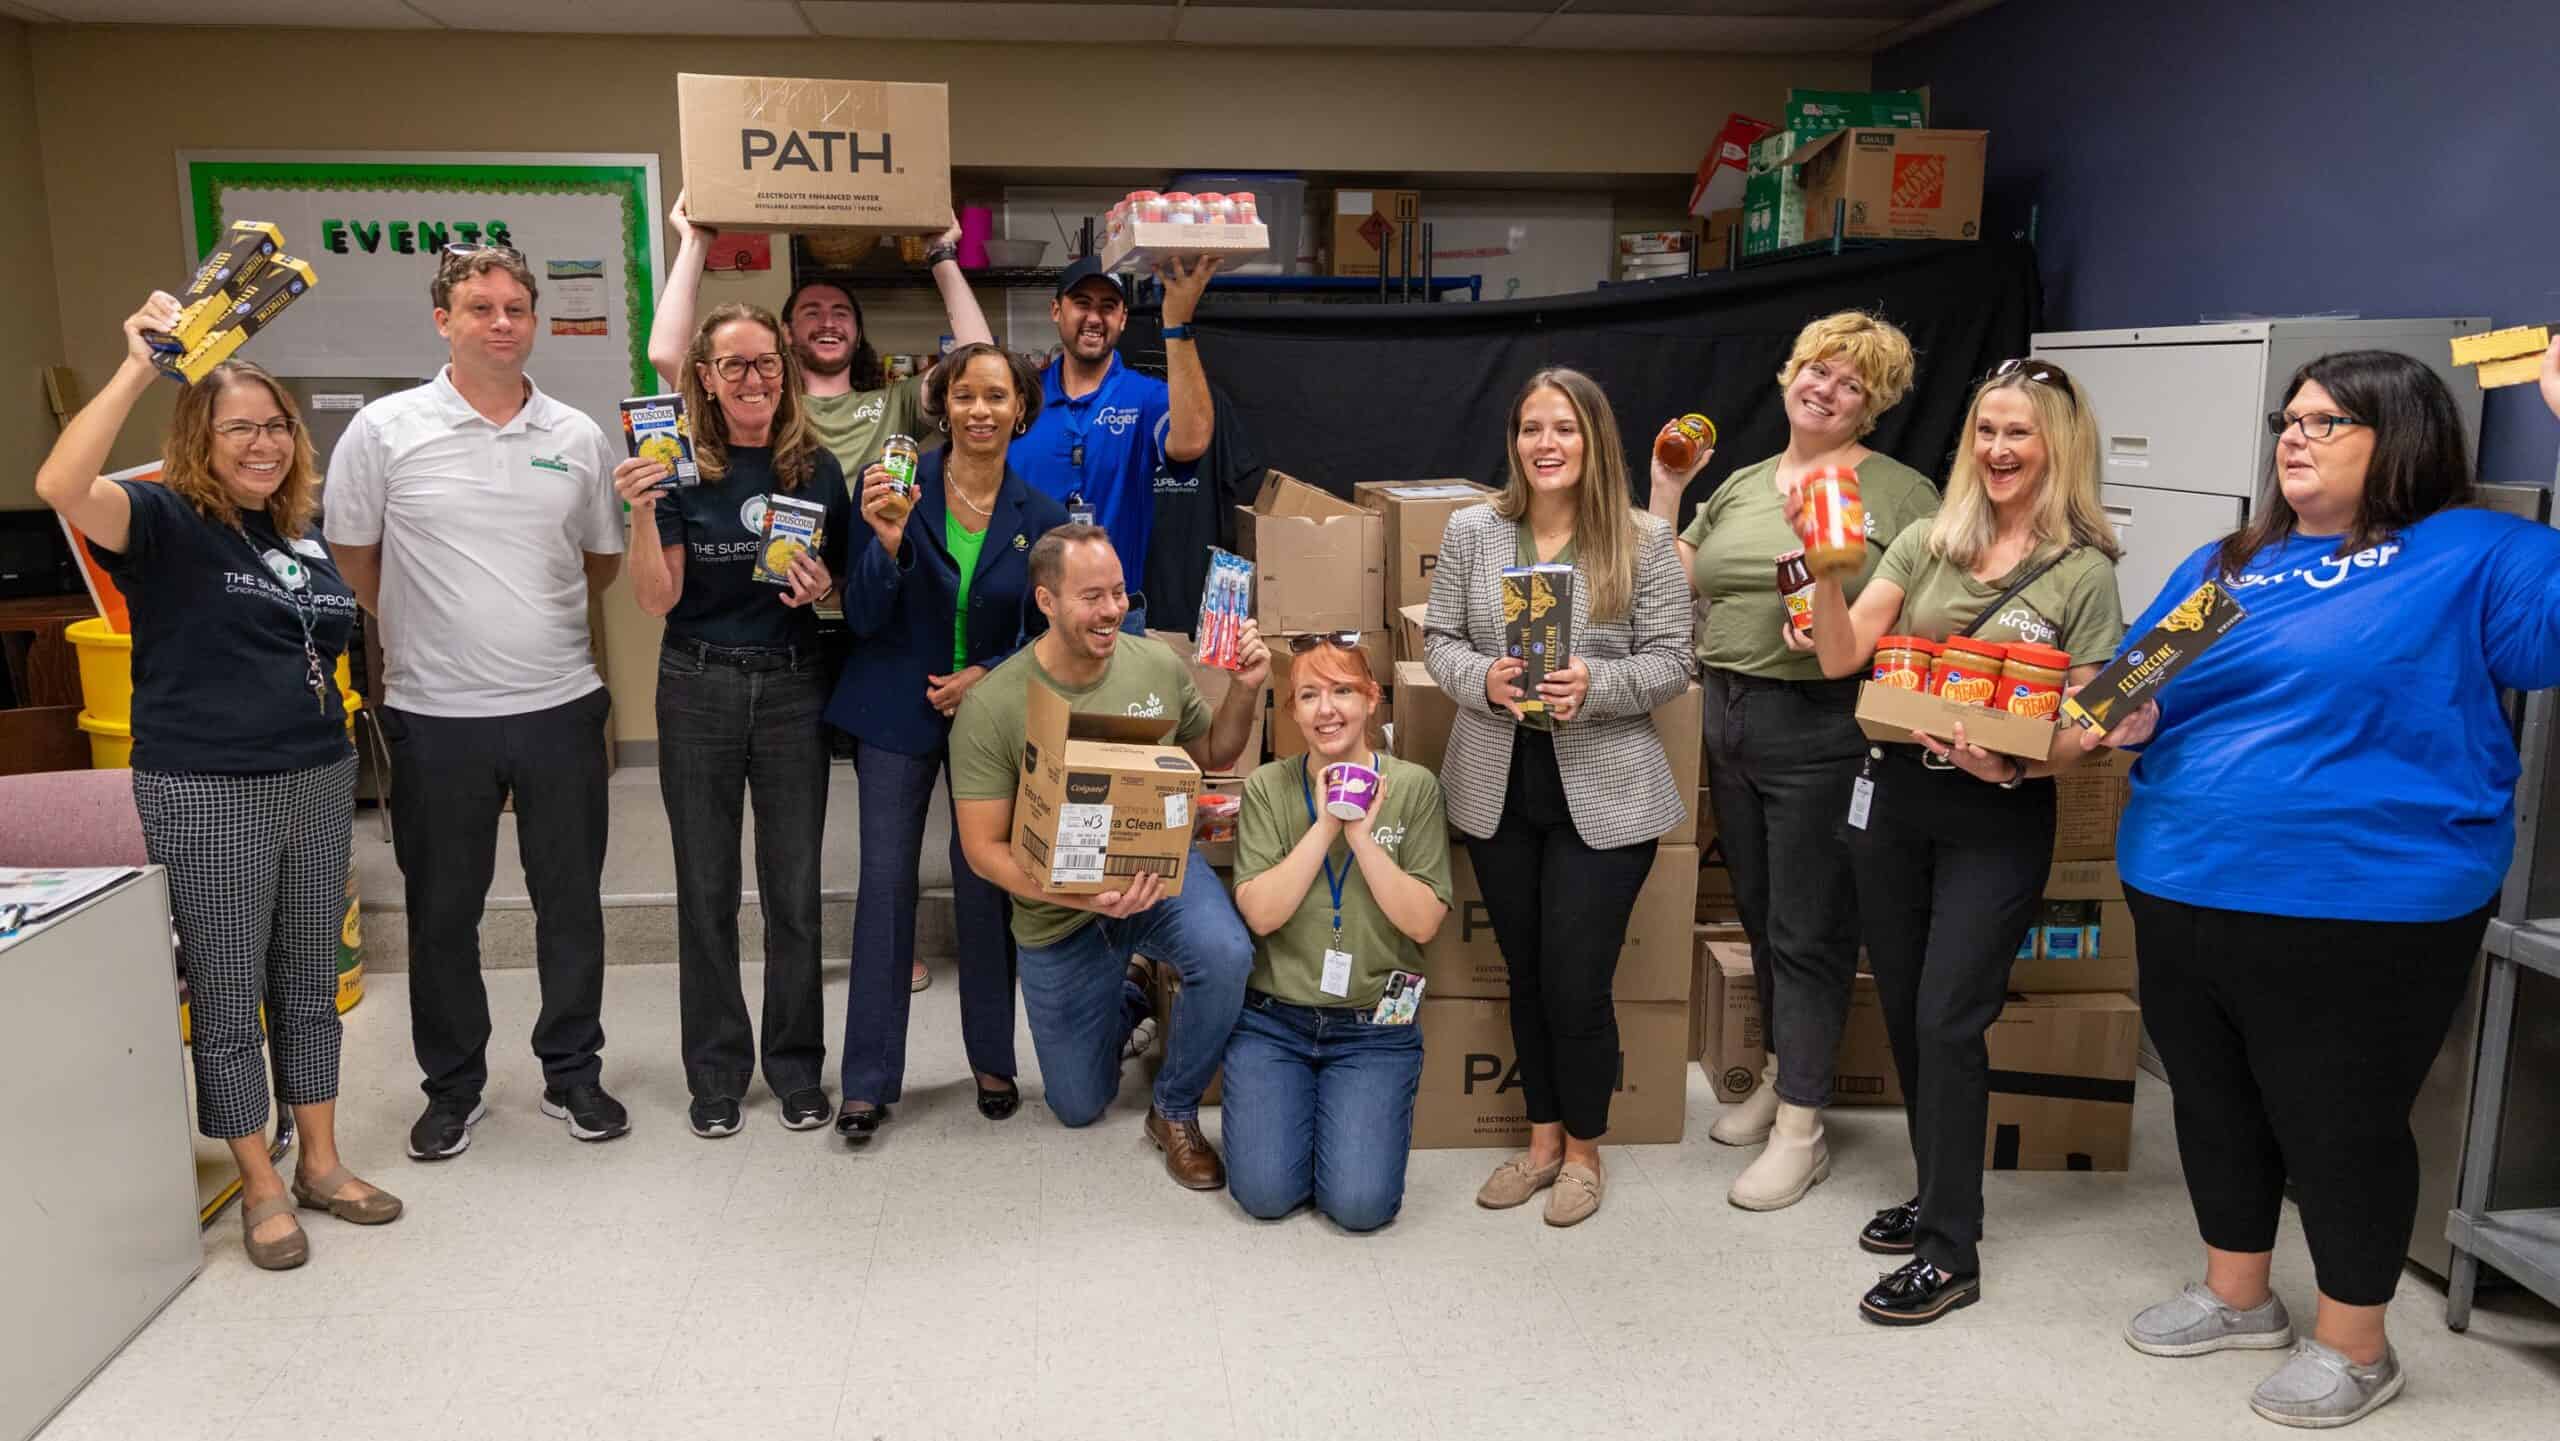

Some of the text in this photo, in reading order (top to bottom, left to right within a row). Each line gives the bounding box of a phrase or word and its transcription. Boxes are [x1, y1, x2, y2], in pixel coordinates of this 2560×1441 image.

[741, 129, 892, 174] PATH
[757, 192, 806, 200] ELECTROLYTE
[809, 193, 851, 201] ENHANCED
[322, 219, 513, 254] EVENTS
[633, 410, 673, 421] COUSCOUS
[1093, 406, 1139, 434] Kroger
[776, 514, 813, 529] COUSCOUS
[692, 542, 715, 555] THE
[224, 571, 256, 586] THE
[257, 578, 295, 602] SURG
[1998, 609, 2056, 642] Kroger
[1544, 625, 1557, 672] FETTUCCINE
[2117, 643, 2175, 693] FETTUCCINE
[1071, 784, 1106, 794] Colgate
[1083, 814, 1104, 830] W3
[1126, 818, 1162, 831] Clean
[1477, 1115, 1527, 1123] ELECTROLYT
